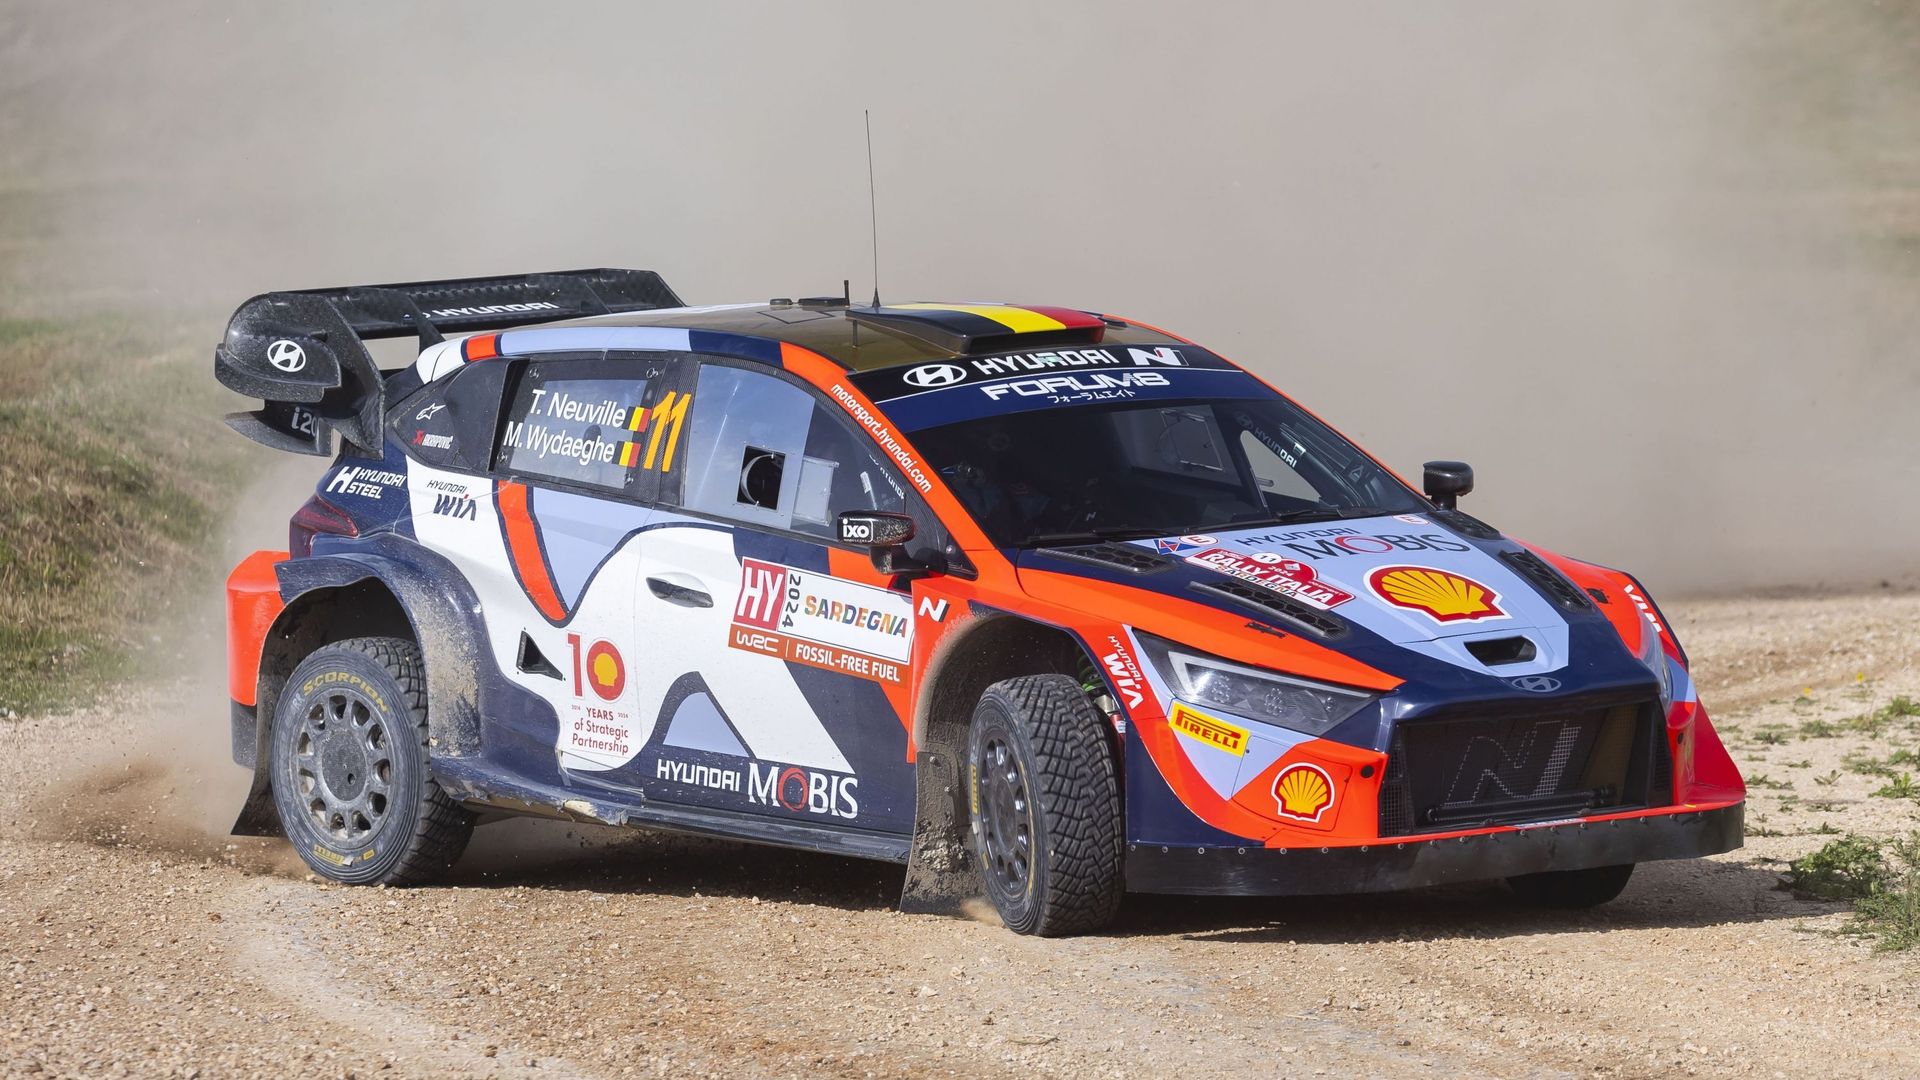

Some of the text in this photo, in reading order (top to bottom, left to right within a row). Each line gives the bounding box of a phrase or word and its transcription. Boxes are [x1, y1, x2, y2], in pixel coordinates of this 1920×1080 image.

[432, 302, 560, 317] HYUNDAI
[971, 350, 1119, 375] HYUNDAI
[979, 372, 1170, 401] FORUM8
[1047, 389, 1135, 403] フォーラムエイト
[529, 389, 626, 427] T. Neuville
[503, 421, 615, 466] M. Wydaeghe
[643, 391, 692, 472] 11
[830, 384, 932, 493] motorsport.hyundai.com
[1254, 427, 1297, 468] HYUNDAI
[347, 482, 384, 500] STEEL
[356, 469, 407, 488] HYUNDAI
[427, 480, 467, 494] HYUNDAI
[842, 519, 869, 538] ixo
[1235, 527, 1361, 546] HYUNDAI
[1259, 554, 1276, 563] 11
[1283, 534, 1471, 560] MOBIS
[737, 567, 784, 622] HY
[1203, 553, 1267, 579] RALLY
[1265, 571, 1334, 603] ITALIA
[782, 573, 801, 628] 2024
[804, 594, 908, 638] SARDEGNA
[736, 630, 900, 682] WRC FOSSIL-FREE FUEL
[1107, 635, 1143, 682] HYUNDAI
[303, 671, 390, 712] SCORPION
[574, 717, 629, 741] of Strategic
[586, 707, 614, 721] YEARS
[1175, 708, 1242, 750] PIRELLI
[572, 733, 629, 756] Partnership
[656, 758, 741, 792] HYUNDAI
[748, 762, 858, 819] MOBIS
